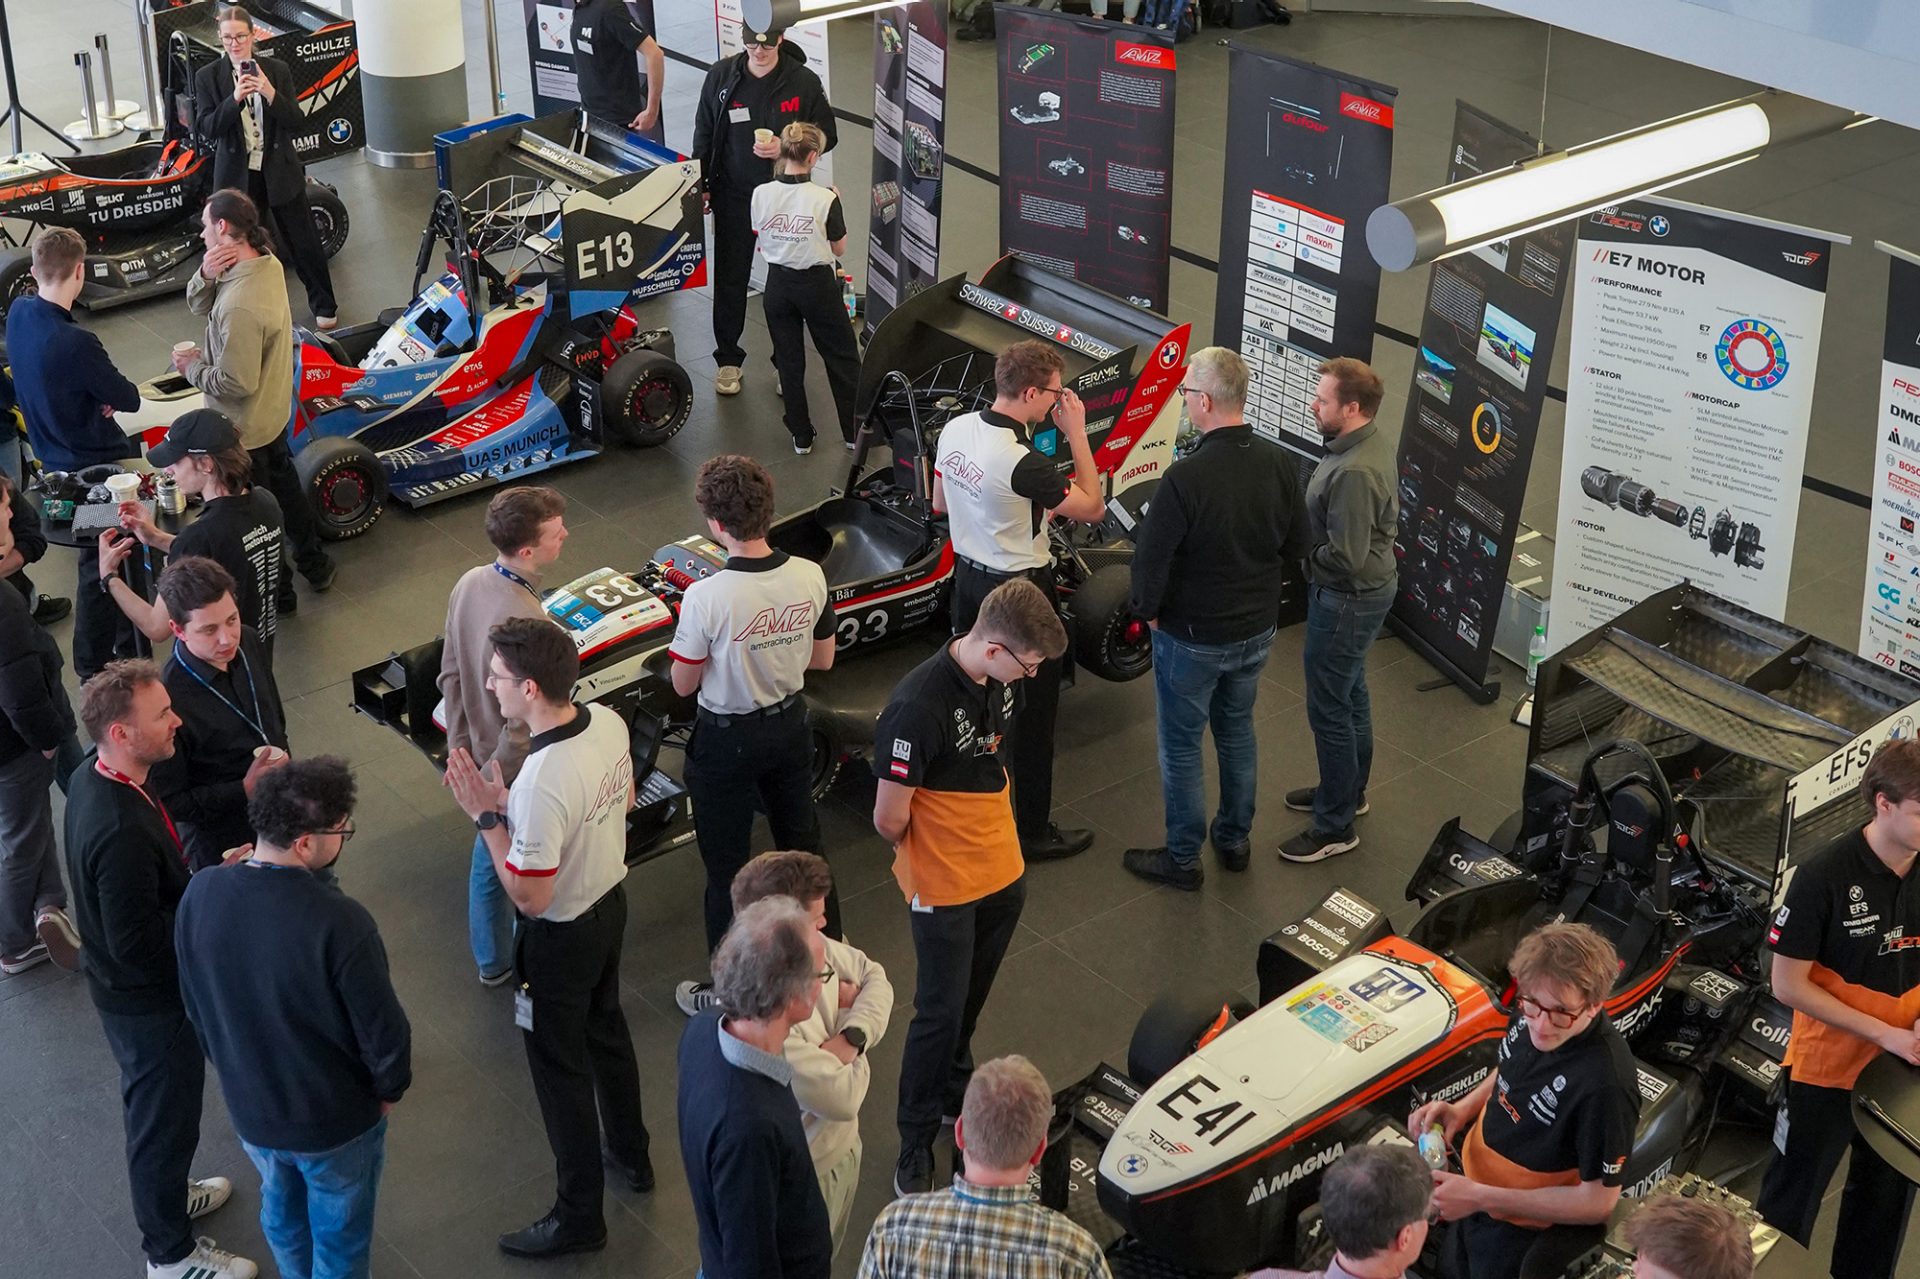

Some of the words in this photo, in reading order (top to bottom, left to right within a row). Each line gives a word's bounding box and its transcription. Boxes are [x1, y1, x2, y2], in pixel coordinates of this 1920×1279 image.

[581, 27, 593, 39] M
[296, 36, 351, 57] SCHULZE
[303, 51, 346, 63] WERKZEUGBAU
[780, 96, 800, 112] M
[1282, 112, 1330, 133] dufour
[568, 159, 594, 176] Design
[88, 211, 110, 224] TU
[113, 195, 183, 220] DRESDEN
[761, 213, 814, 235] AMZ
[1306, 234, 1333, 250] maxon
[577, 231, 635, 280] E13
[676, 252, 701, 262] Ansys
[1637, 257, 1706, 285] MOTOR
[632, 279, 681, 296] HUFSCHMIED
[959, 283, 1003, 314] Schweiz
[1018, 309, 1056, 336] Suisse
[1698, 323, 1711, 333] E7
[1696, 351, 1708, 361] E6
[1079, 364, 1120, 387] FERAMIC
[383, 390, 412, 400] SIEMENS
[469, 447, 500, 468] UAS
[504, 424, 561, 457] MUNICH
[1142, 440, 1167, 450] WKK
[1121, 461, 1158, 484] maxon
[242, 524, 268, 544] munich
[244, 526, 282, 552] motorsport
[836, 588, 856, 601] Bär
[733, 600, 812, 641] AMZ
[836, 608, 889, 652] 33
[750, 633, 804, 651] amzracing.ch
[895, 740, 911, 753] TU
[1829, 739, 1871, 785] EFS
[1325, 903, 1367, 929] FRANKEN
[1850, 901, 1869, 914] EFS
[1303, 917, 1350, 947] HOERBIGER
[1297, 932, 1339, 961] BOSCH
[1751, 1017, 1791, 1051] Colli
[1156, 1073, 1258, 1148] E41
[1270, 1141, 1345, 1195] MAGNA
